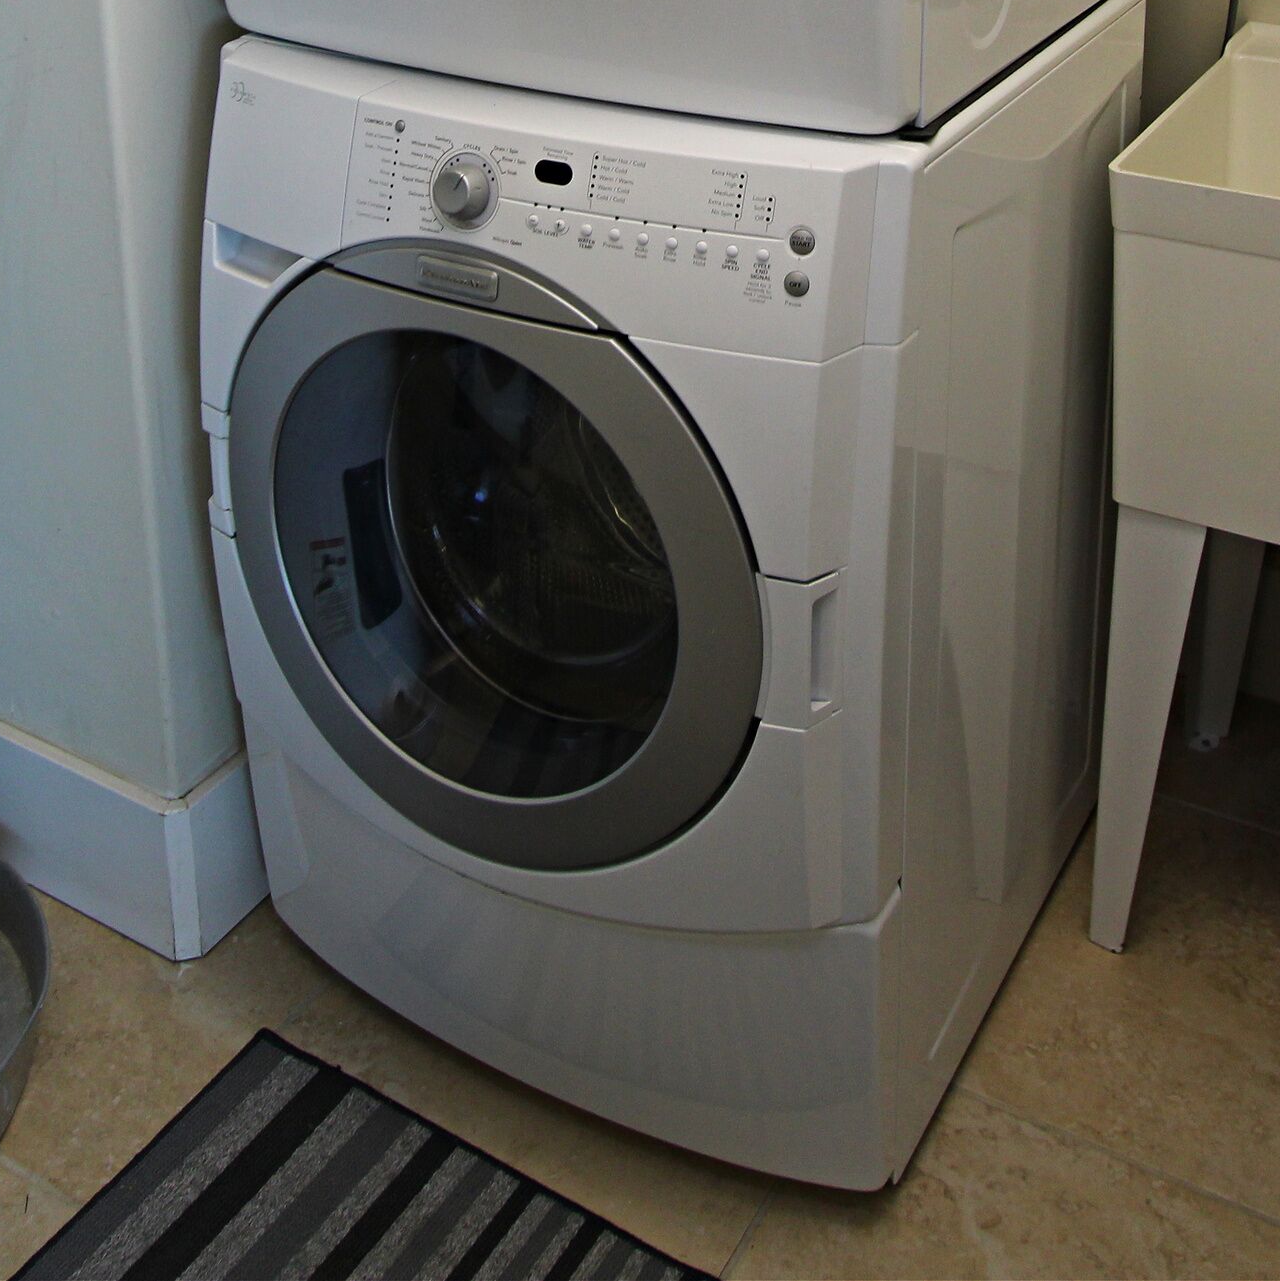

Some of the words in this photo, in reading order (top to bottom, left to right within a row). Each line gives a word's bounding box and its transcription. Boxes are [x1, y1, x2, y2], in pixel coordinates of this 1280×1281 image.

[463, 144, 481, 152] CYCLES
[602, 155, 617, 164] Super
[633, 160, 646, 168] Cold
[614, 166, 628, 175] Cold
[712, 169, 725, 177] Extra
[727, 171, 738, 179] High
[598, 184, 613, 192] Warm
[617, 186, 630, 194] Cold
[724, 181, 736, 189] High
[714, 190, 734, 198] Medium
[596, 194, 608, 202] Cold
[613, 196, 625, 204] Cold
[708, 198, 722, 206] Extra
[721, 210, 732, 218] Spin
[544, 230, 558, 238] LEVEL
[792, 240, 811, 248] START
[722, 264, 739, 272] SPEED
[750, 274, 771, 282] SIGNAL
[789, 280, 801, 288] OFF
